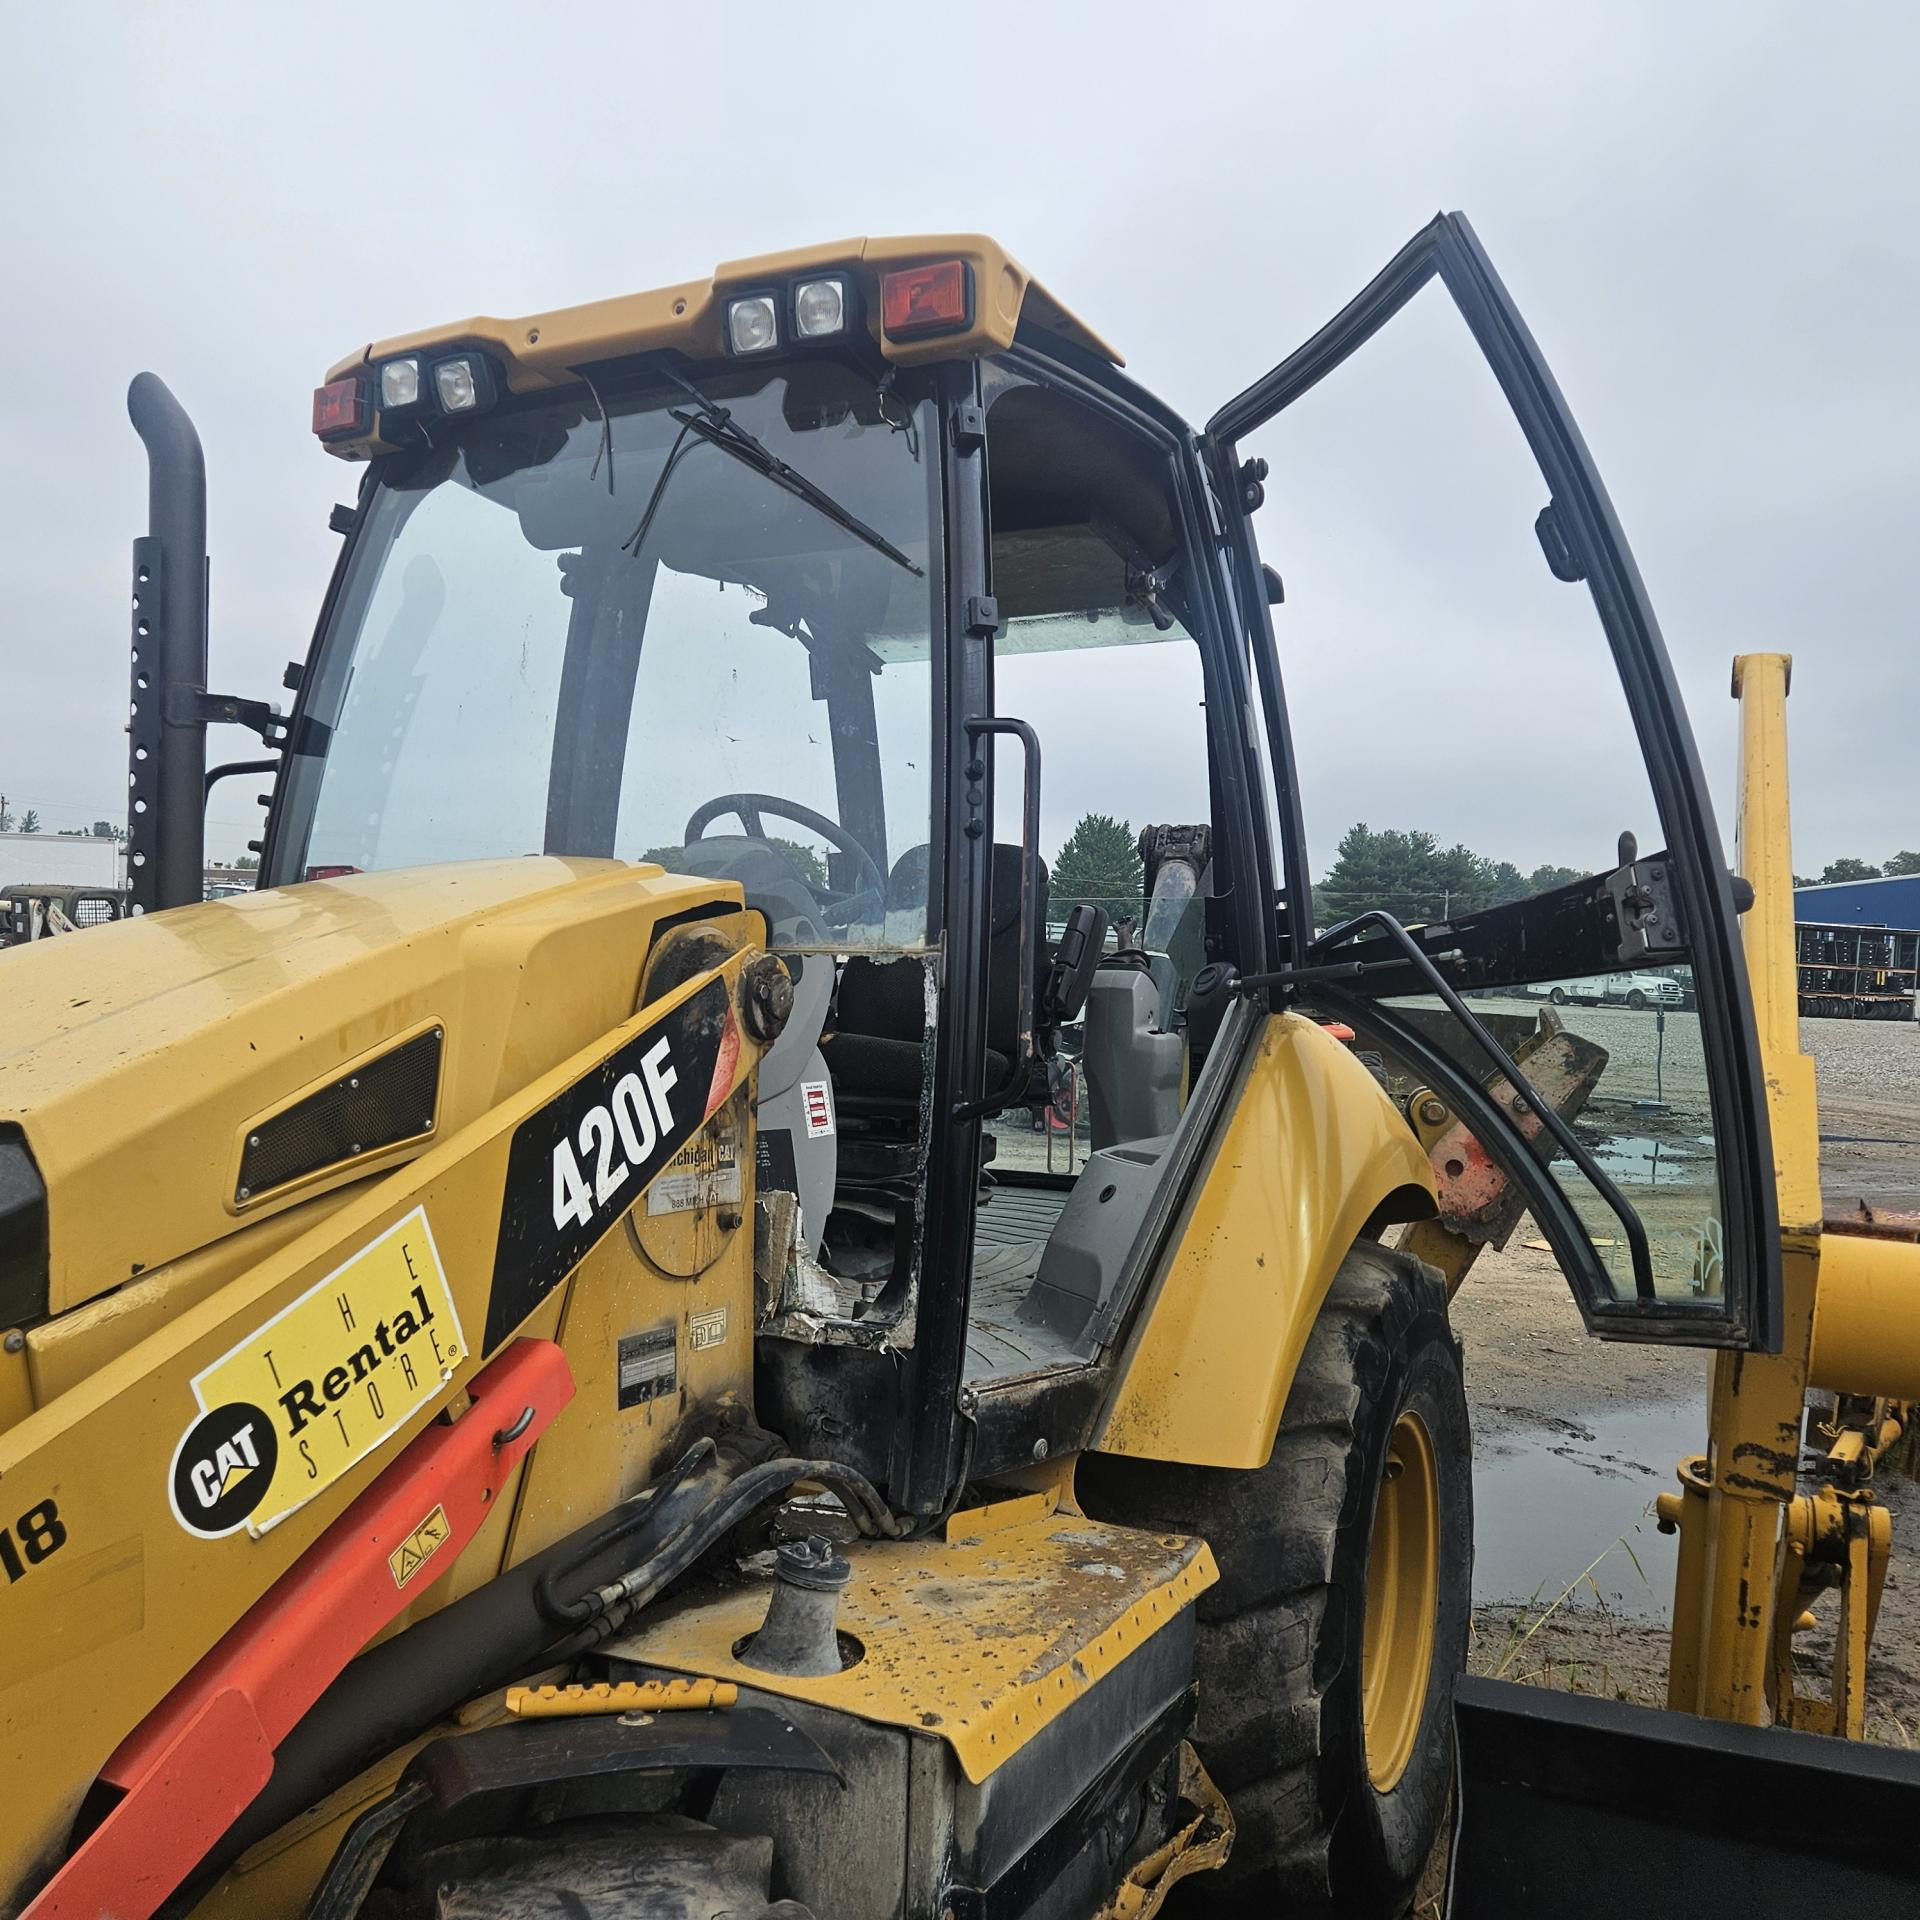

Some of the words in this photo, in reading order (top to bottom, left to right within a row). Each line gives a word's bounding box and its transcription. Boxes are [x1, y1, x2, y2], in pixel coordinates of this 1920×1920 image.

[553, 1035, 678, 1231] 420F
[718, 1143, 735, 1161] CAT
[278, 1284, 435, 1438] Rental
[190, 1422, 260, 1508] CAT
